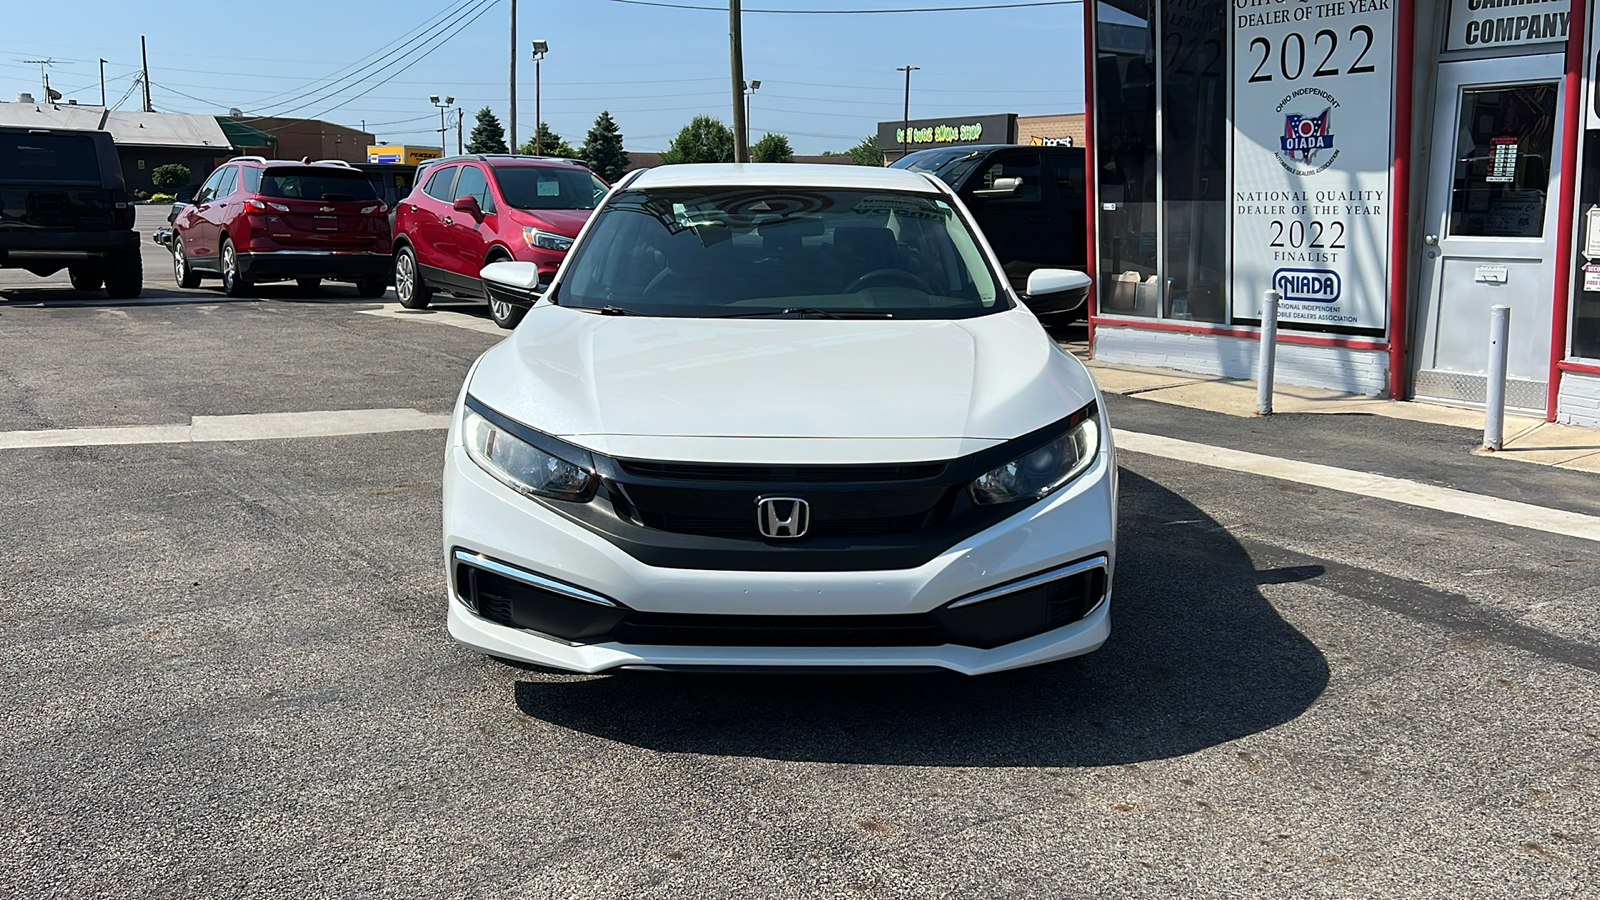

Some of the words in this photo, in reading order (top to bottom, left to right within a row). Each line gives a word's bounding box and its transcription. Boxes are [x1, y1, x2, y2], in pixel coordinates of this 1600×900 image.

[1238, 10, 1290, 29] DEALER
[1293, 6, 1313, 21] OF
[1315, 2, 1345, 19] THE
[1349, 0, 1389, 14] YEAR
[1465, 11, 1570, 45] COMPANY
[1247, 24, 1375, 83] 2022
[1275, 95, 1292, 113] OHIO
[1291, 87, 1341, 109] INDEPENDENT
[959, 122, 982, 141] SHOP
[1286, 136, 1325, 150] OIADA
[1236, 191, 1309, 202] NATIONAL
[1315, 190, 1384, 203] QUALITY
[1238, 205, 1286, 216] DEALER
[1291, 205, 1308, 216] OF
[1313, 205, 1340, 216] THE
[1345, 205, 1381, 216] YEAR
[1269, 220, 1346, 249] 2022
[1273, 251, 1338, 263] FINALIST
[1278, 275, 1334, 299] NIADA
[1292, 312, 1317, 320] DEALERS
[1317, 315, 1358, 323] ASSOCIATION
[1301, 304, 1341, 313] INDEPENDENT
